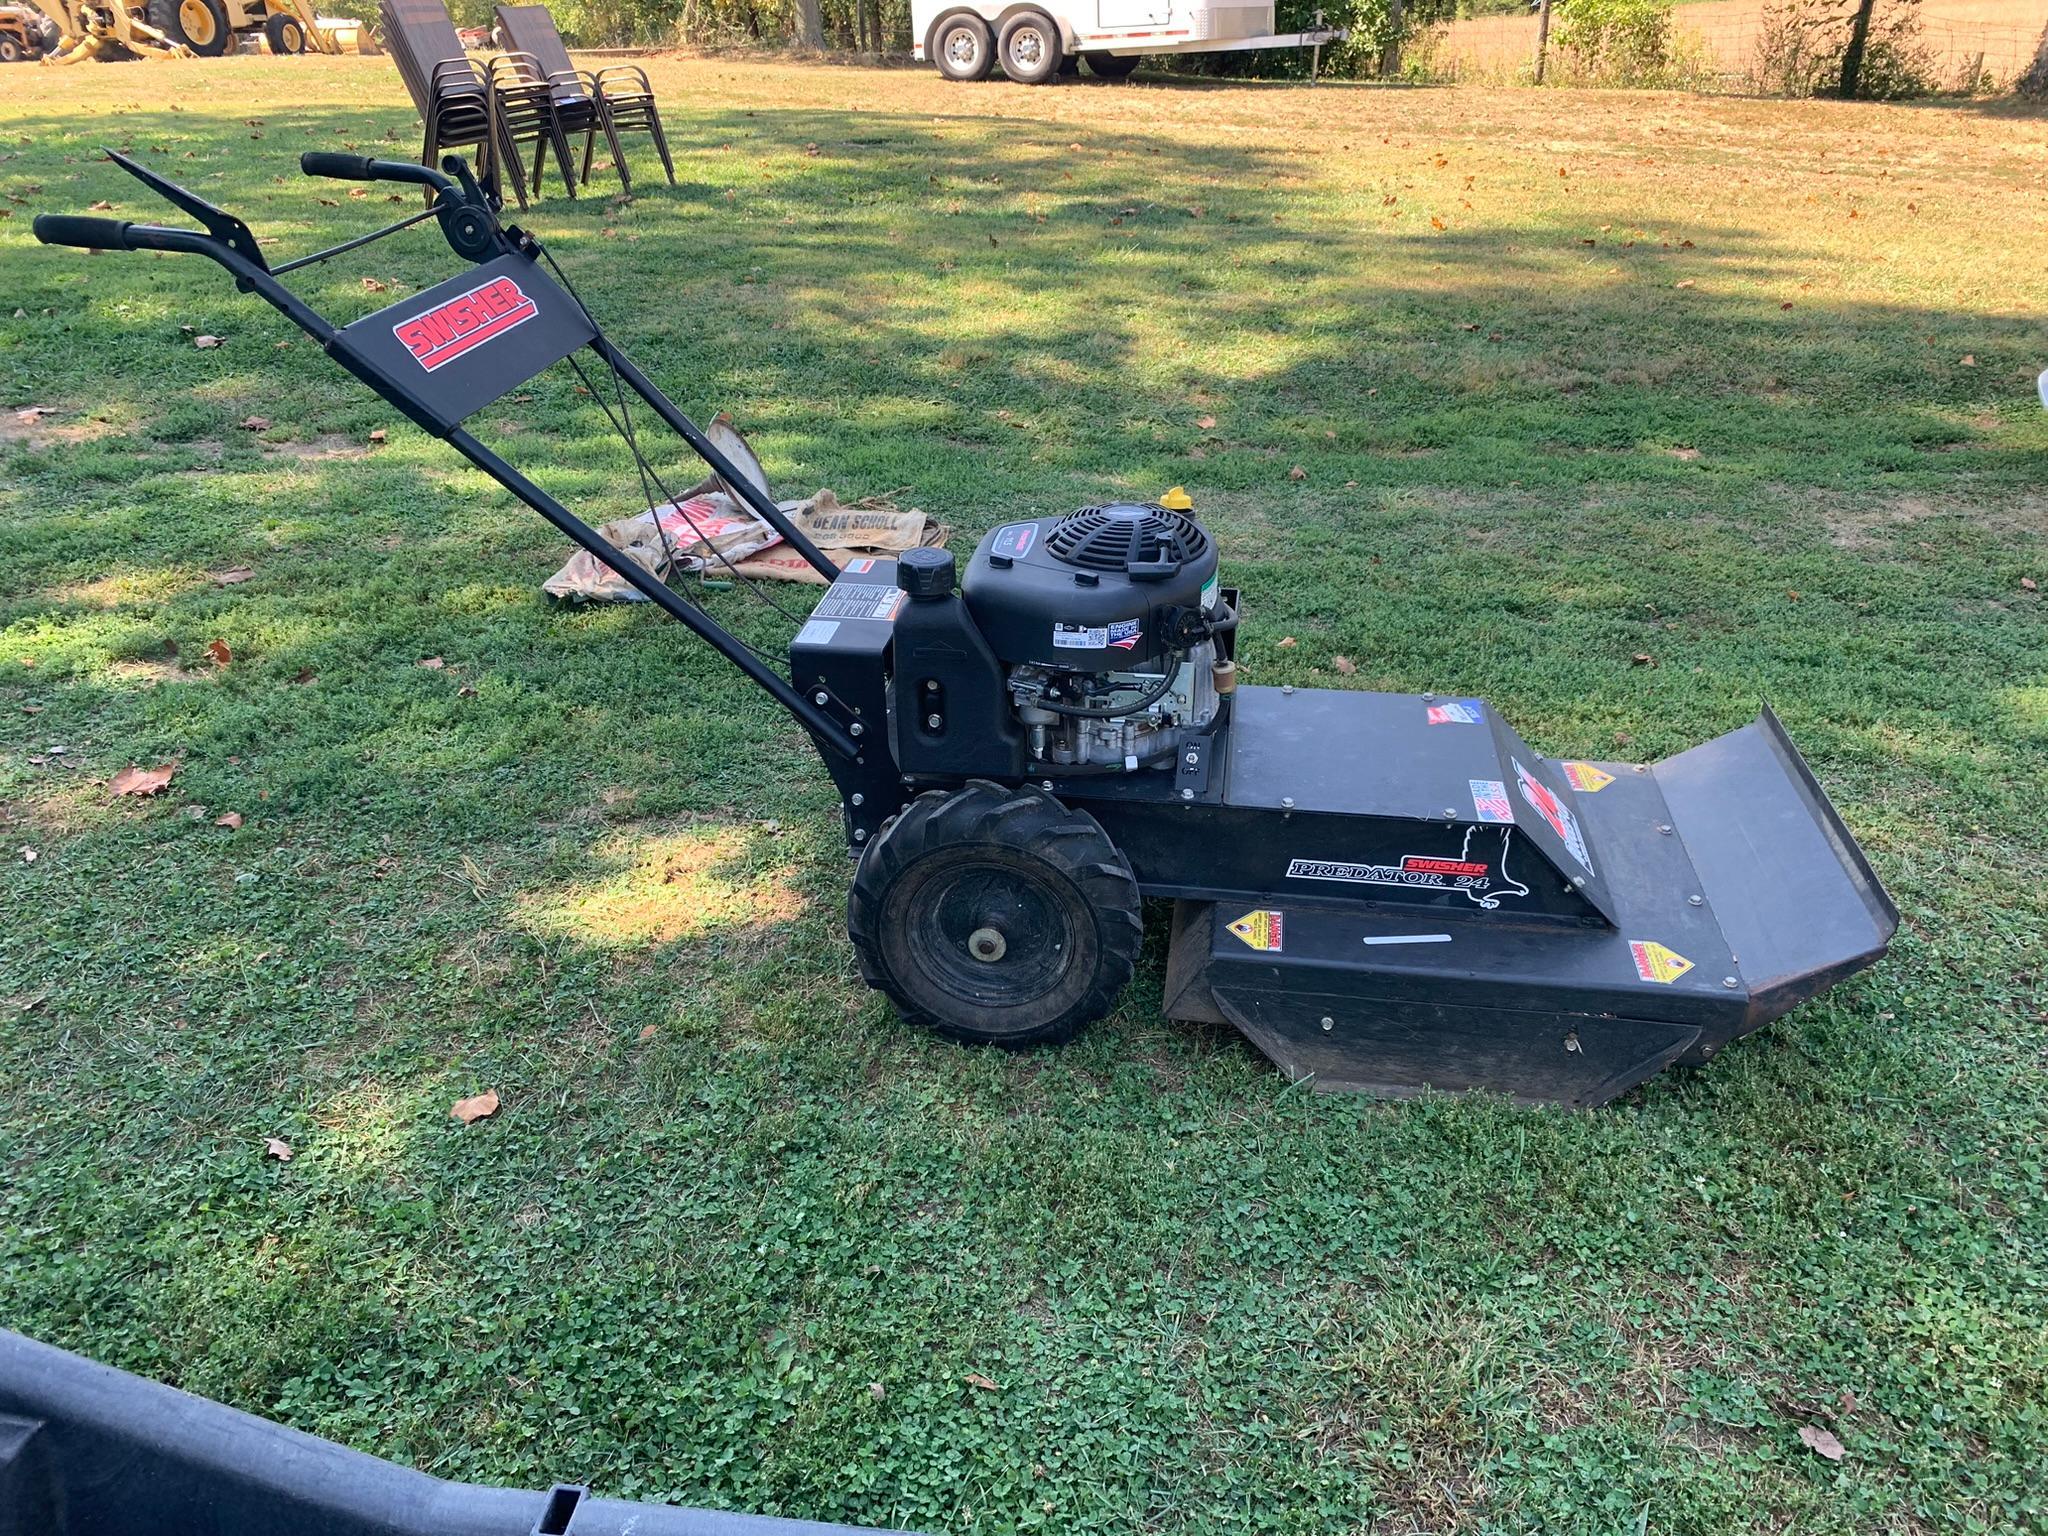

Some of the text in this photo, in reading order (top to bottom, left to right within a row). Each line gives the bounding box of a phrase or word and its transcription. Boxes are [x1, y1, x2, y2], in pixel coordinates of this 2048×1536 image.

[394, 278, 533, 358] SWISHER
[813, 514, 898, 531] DEAN SCHOLL
[1185, 741, 1200, 750] ON
[1181, 767, 1200, 776] OFF
[1405, 858, 1489, 873] SWISHER
[1291, 862, 1491, 889] PREDATOR 24
